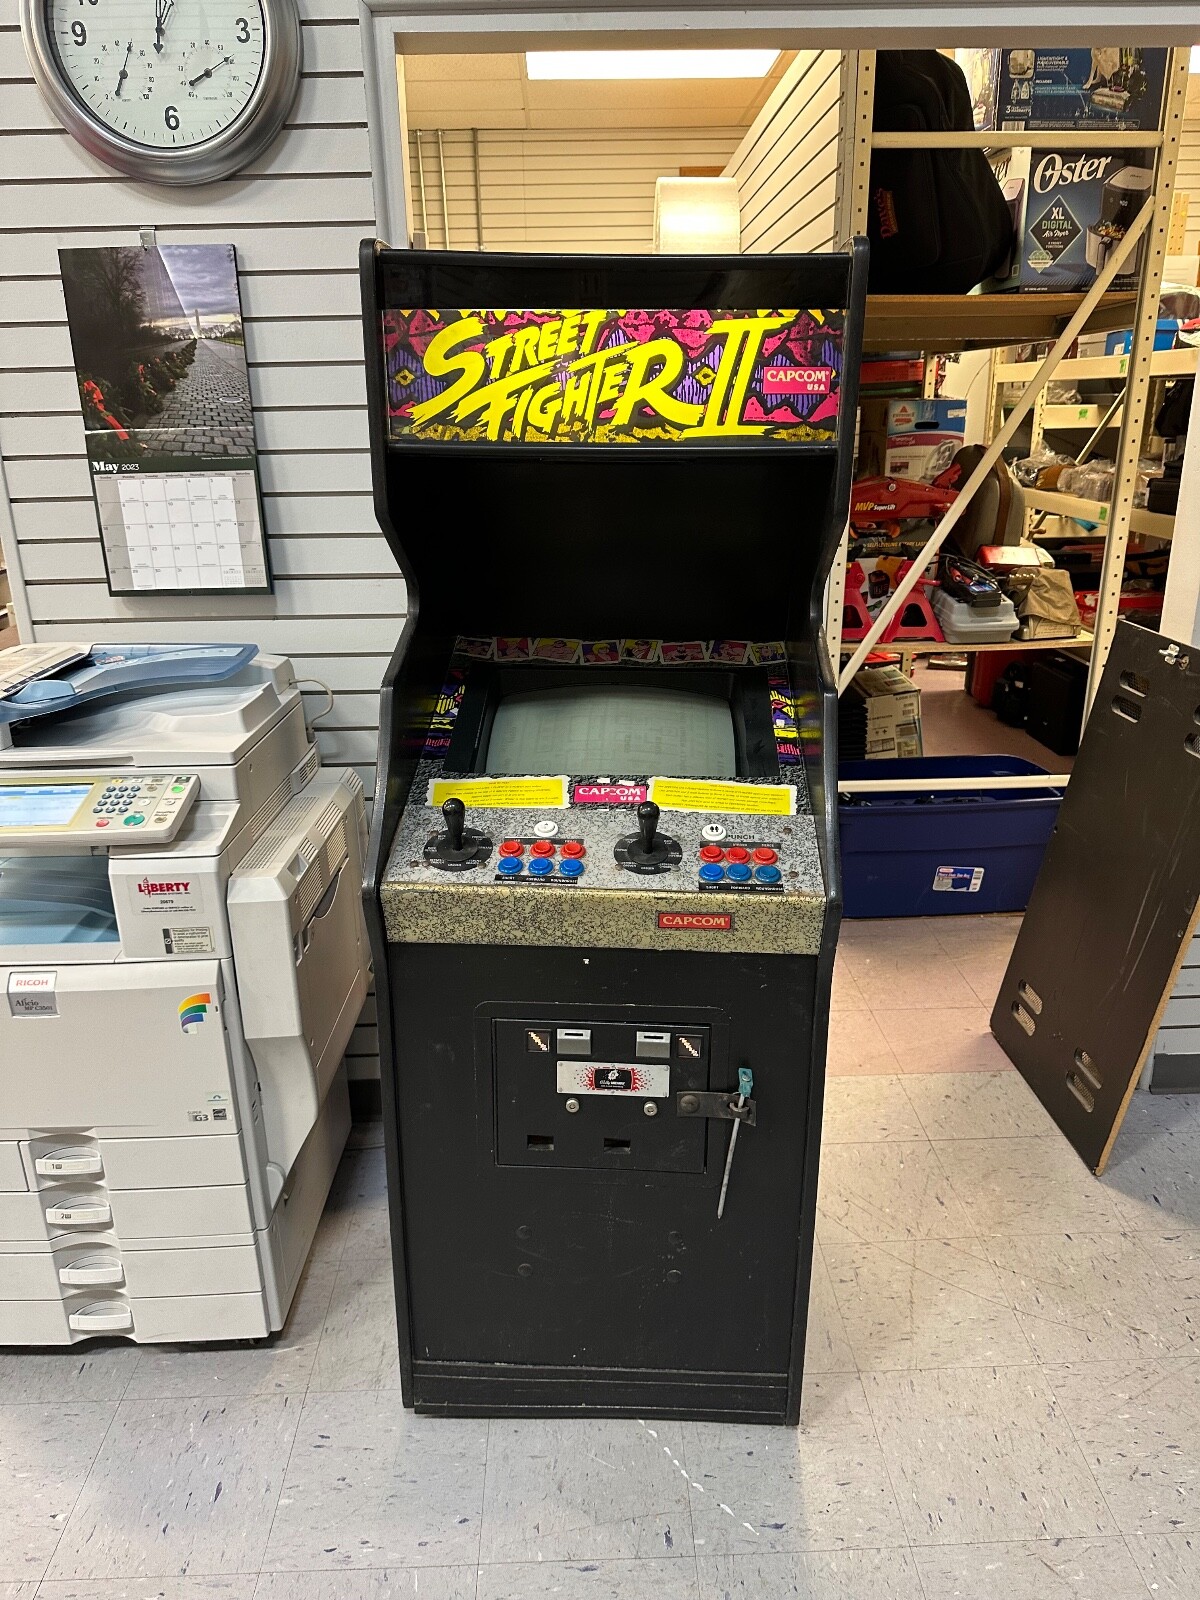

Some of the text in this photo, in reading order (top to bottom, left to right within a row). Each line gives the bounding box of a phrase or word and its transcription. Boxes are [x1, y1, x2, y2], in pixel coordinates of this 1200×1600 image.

[71, 20, 87, 46] 9
[235, 17, 250, 43] 3
[164, 105, 180, 130] 6
[1033, 153, 1112, 194] Oster
[1051, 207, 1065, 220] XL
[1042, 221, 1073, 230] DIGITAL
[405, 313, 607, 427] STREET
[766, 370, 826, 382] CAPCOM
[447, 338, 706, 440] FIGHTER
[806, 383, 825, 391] USA
[92, 461, 140, 474] May 2023
[854, 501, 874, 511] MVP
[662, 916, 726, 926] CAPCOM
[194, 1114, 209, 1122] G3
